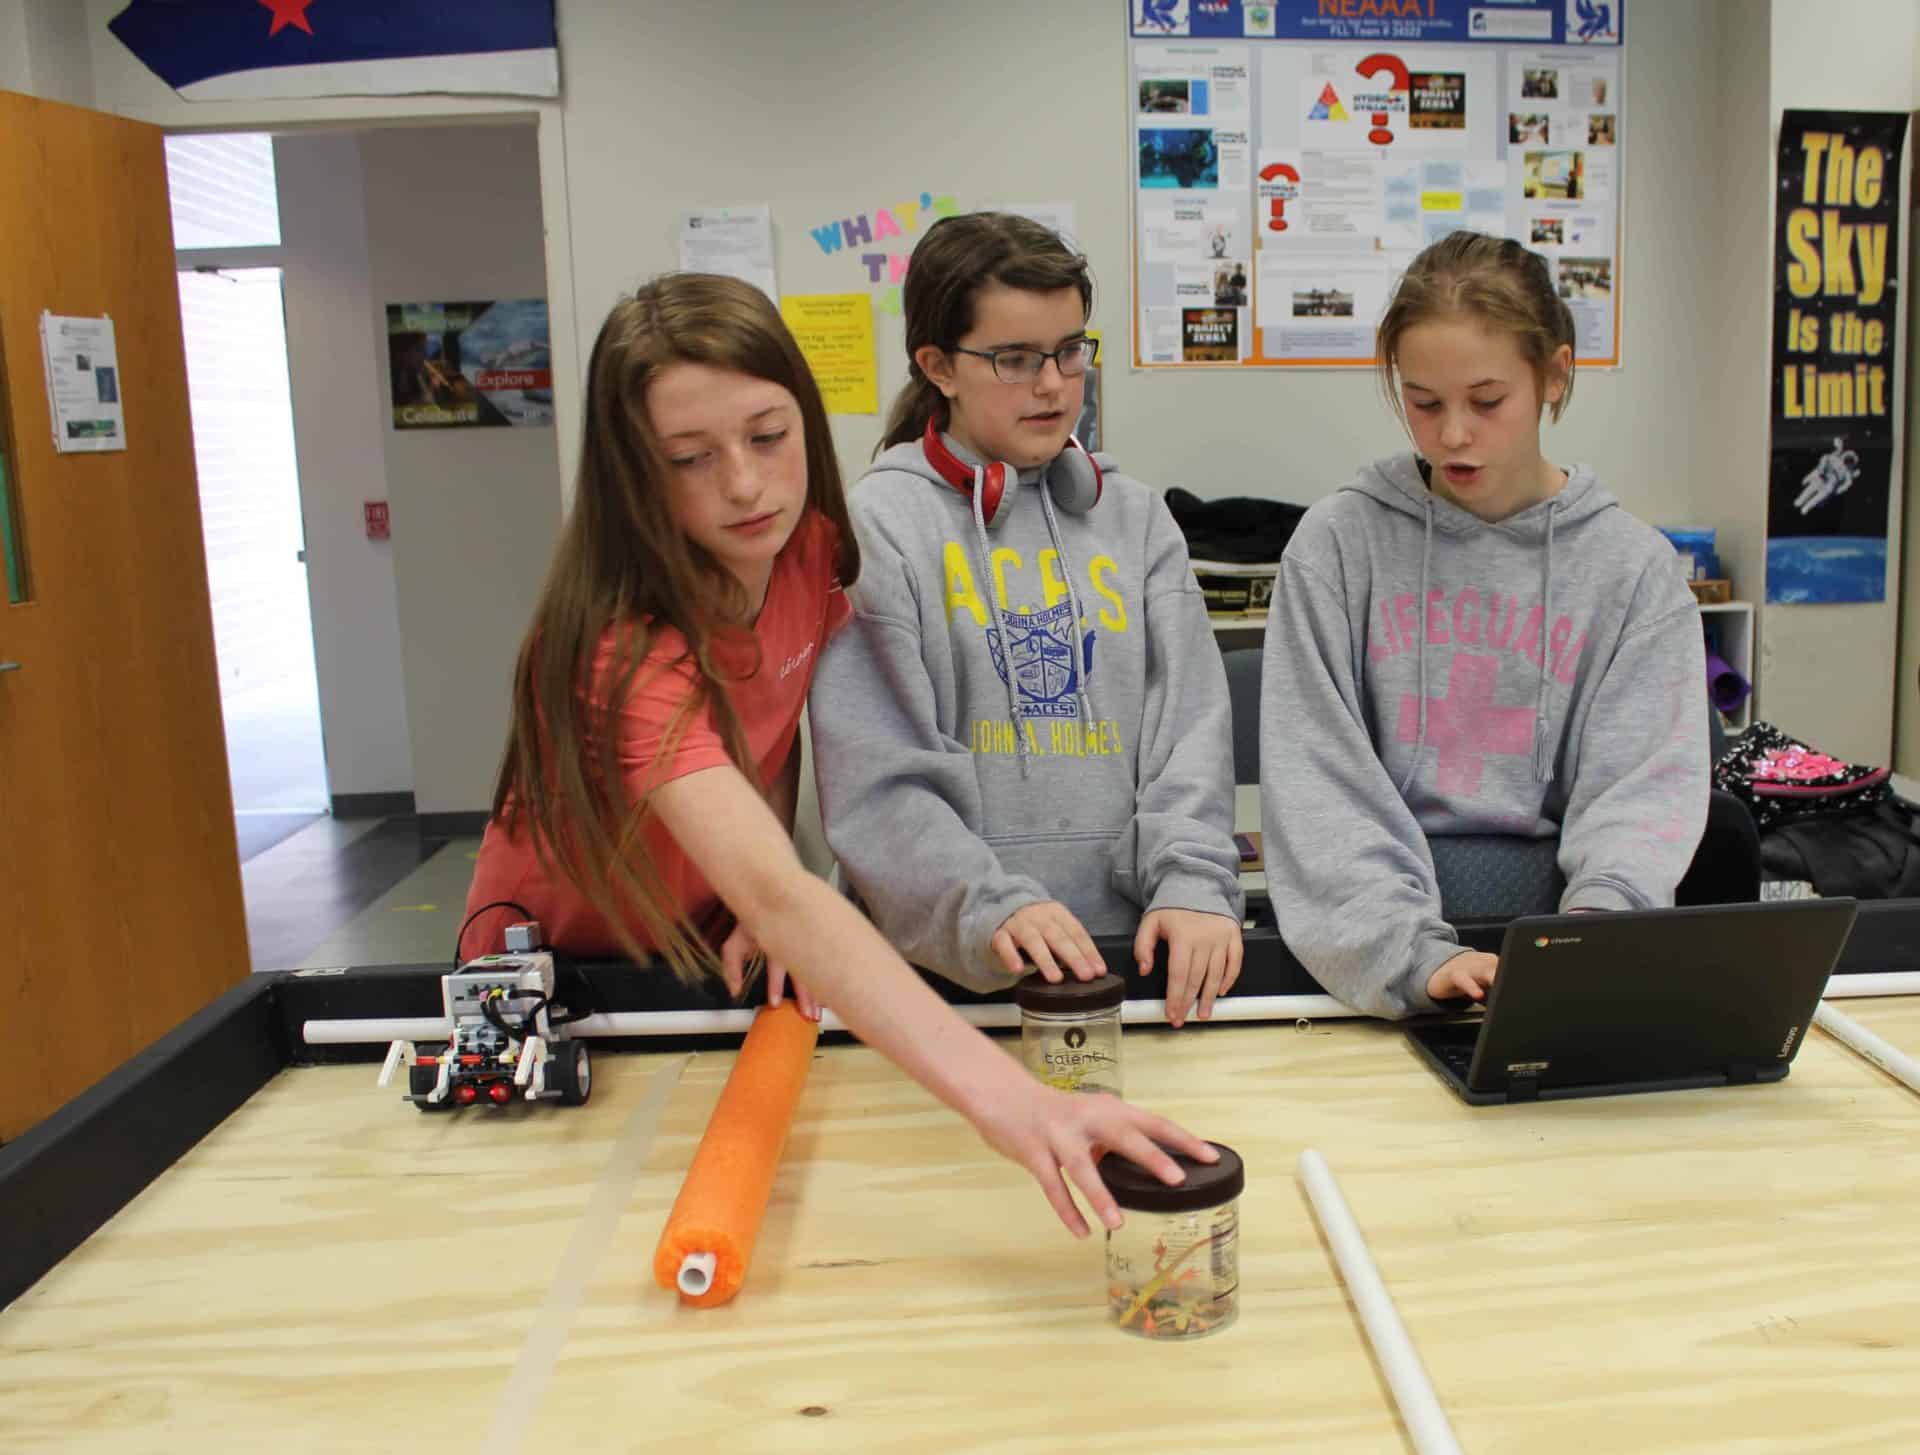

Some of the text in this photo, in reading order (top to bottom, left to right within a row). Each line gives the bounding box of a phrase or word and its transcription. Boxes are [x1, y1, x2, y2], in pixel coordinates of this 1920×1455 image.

[1801, 132, 1884, 208] The
[1787, 208, 1888, 305] Sky
[1830, 312, 1883, 356] the
[477, 369, 536, 390] Explore
[1783, 364, 1886, 420] Limit
[1050, 719, 1124, 758] HOLMES
[1776, 1025, 1800, 1058] Lenovo
